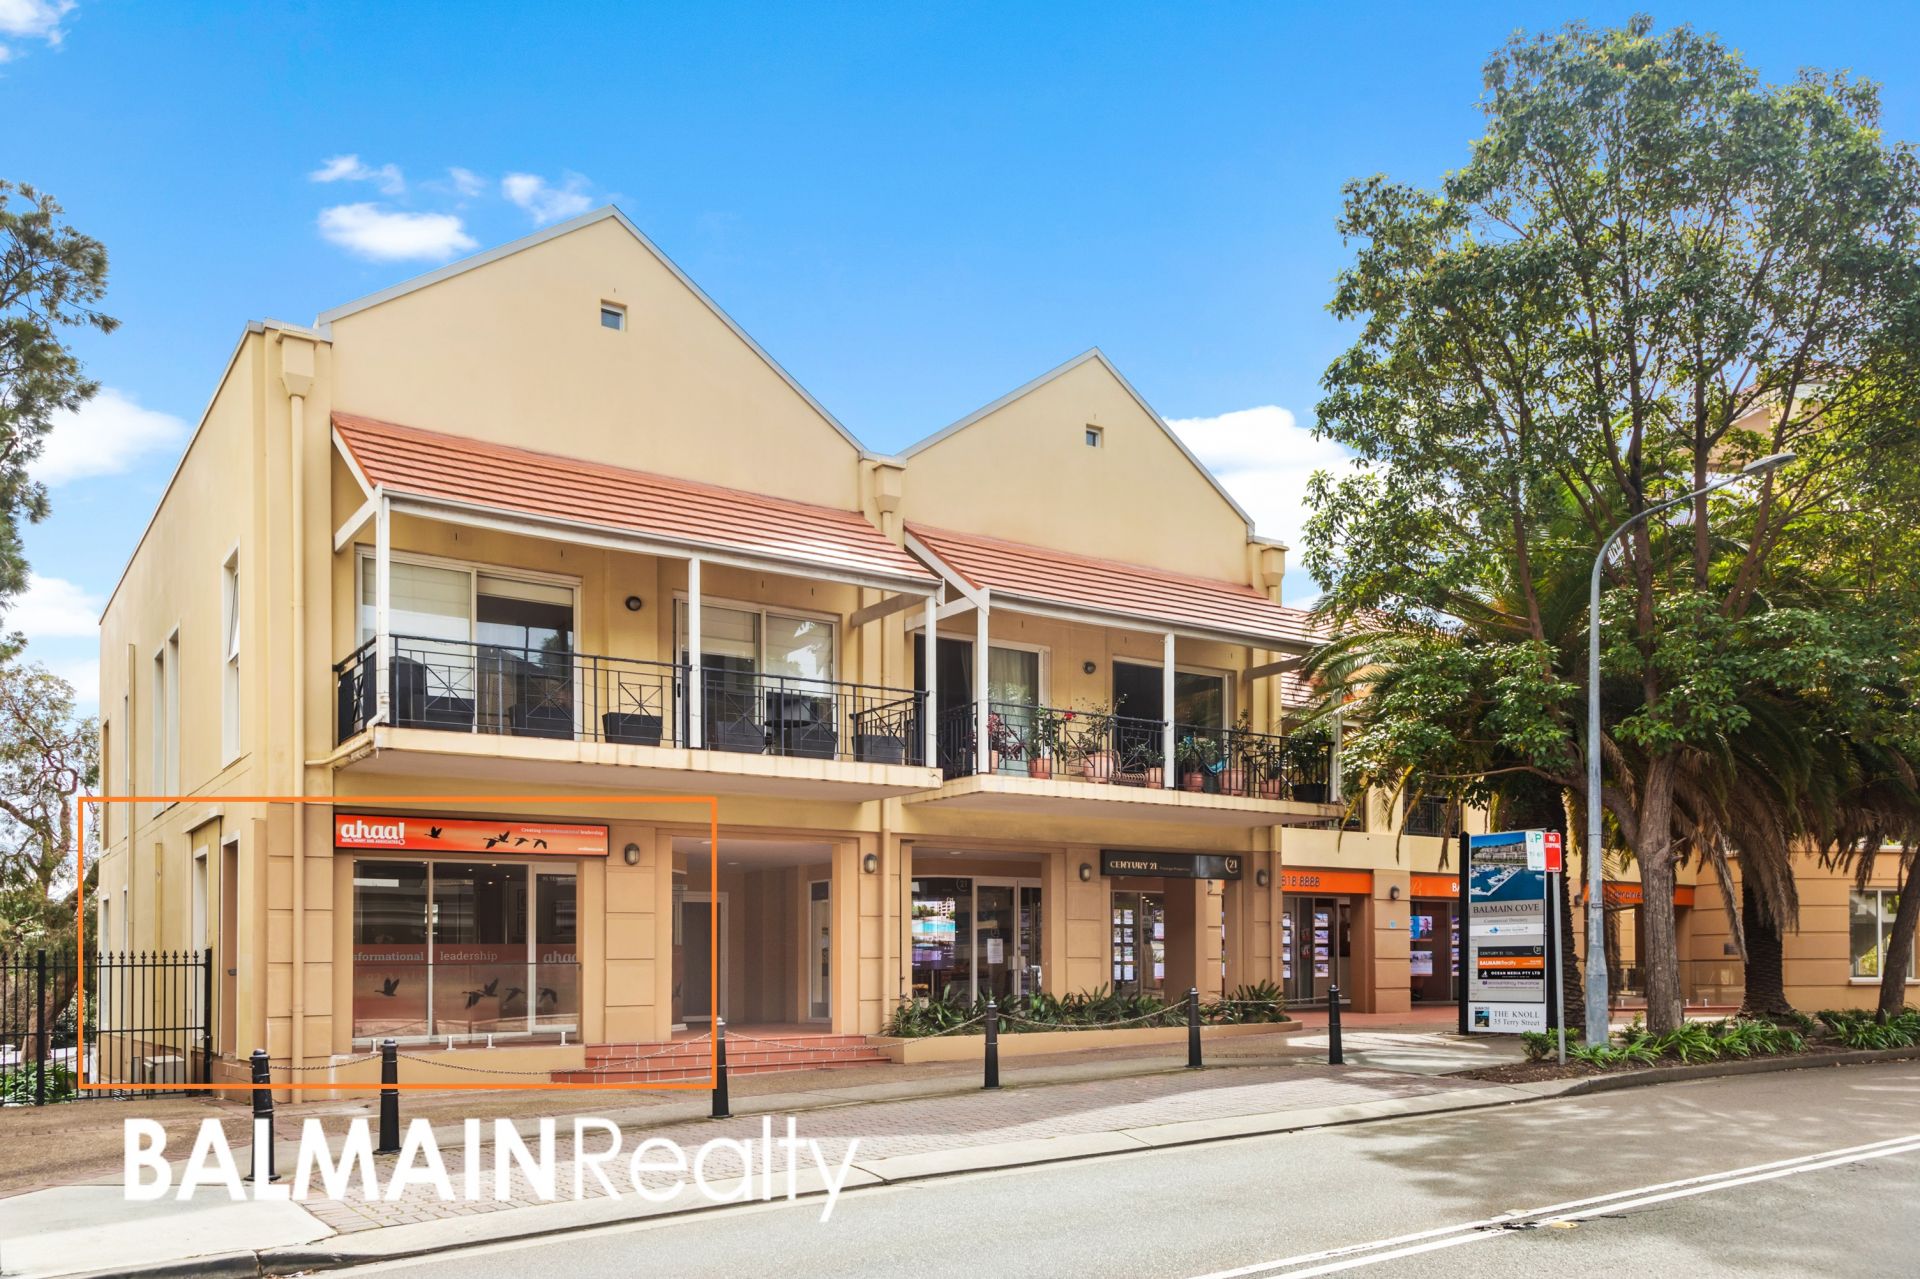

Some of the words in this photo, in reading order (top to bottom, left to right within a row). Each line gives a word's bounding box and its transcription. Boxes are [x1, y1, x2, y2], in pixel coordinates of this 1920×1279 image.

[341, 820, 405, 845] ahaa!
[1109, 860, 1148, 870] CENTURY
[1149, 862, 1157, 870] 21
[1299, 875, 1320, 887] 8888
[1473, 904, 1513, 914] BALMAIN
[1514, 903, 1540, 912] COVE
[440, 950, 498, 962] leadership
[1493, 1010, 1508, 1018] THE
[1512, 1010, 1540, 1019] KNOLL
